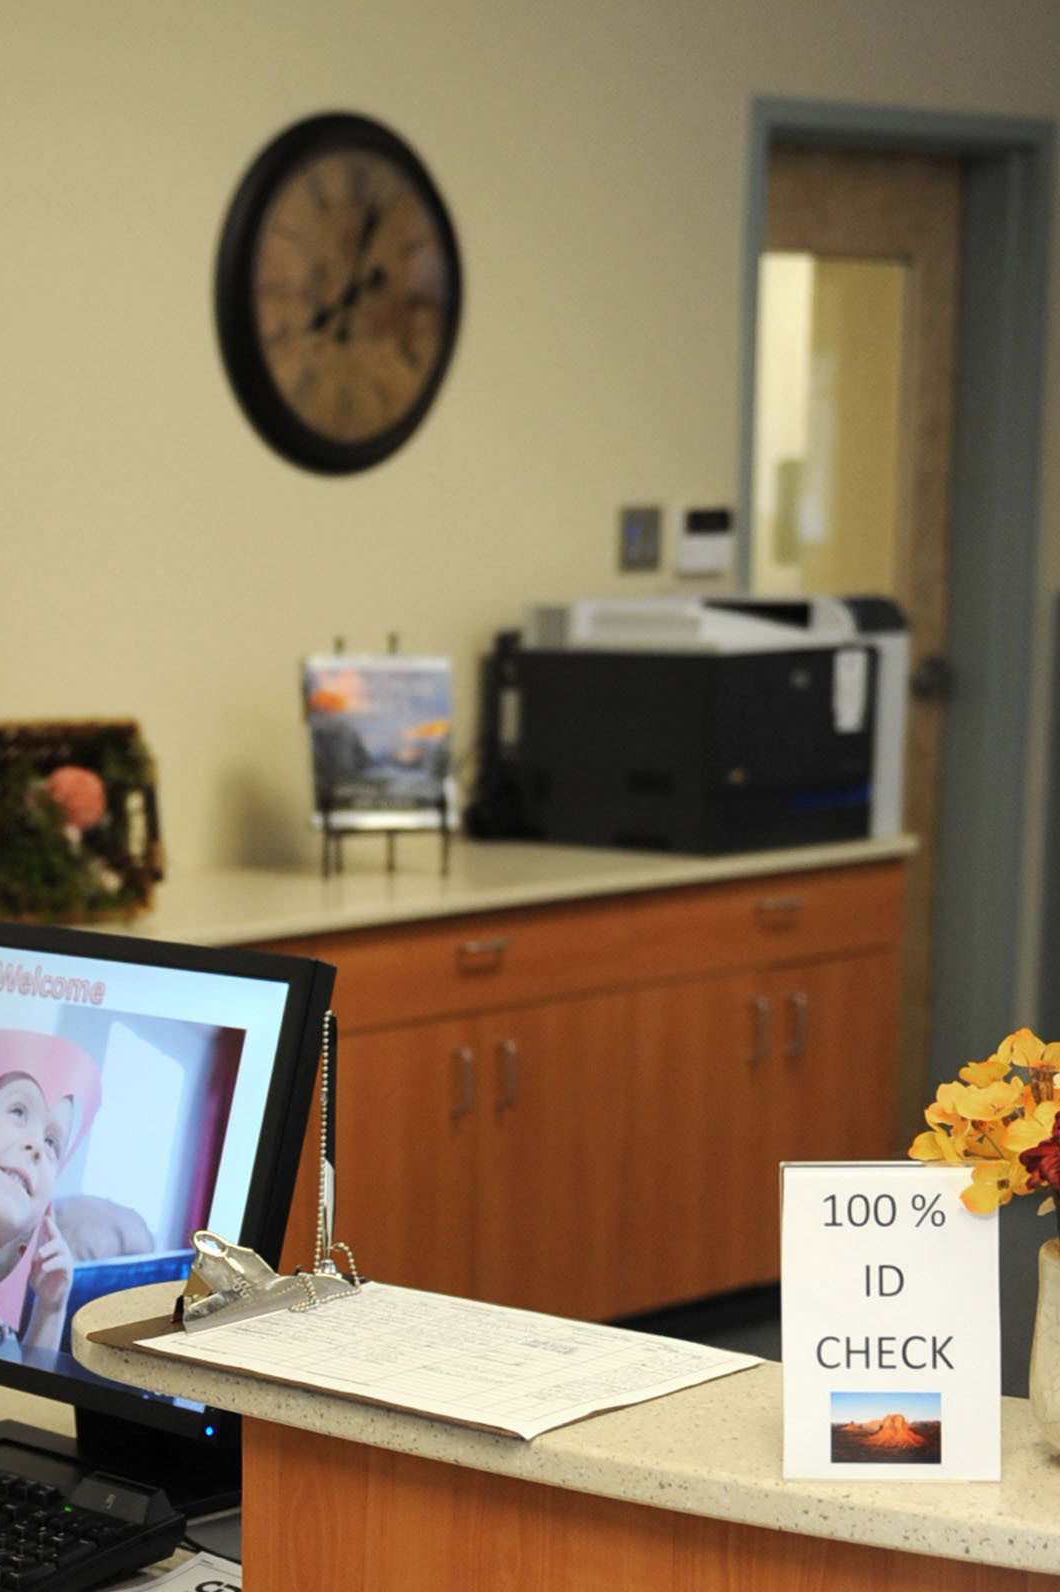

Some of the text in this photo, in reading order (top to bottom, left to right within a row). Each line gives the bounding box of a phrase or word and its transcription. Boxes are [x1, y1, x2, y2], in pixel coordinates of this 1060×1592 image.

[822, 1193, 946, 1228] 100 %
[865, 1264, 905, 1297] ID
[816, 1336, 955, 1369] CHECK
